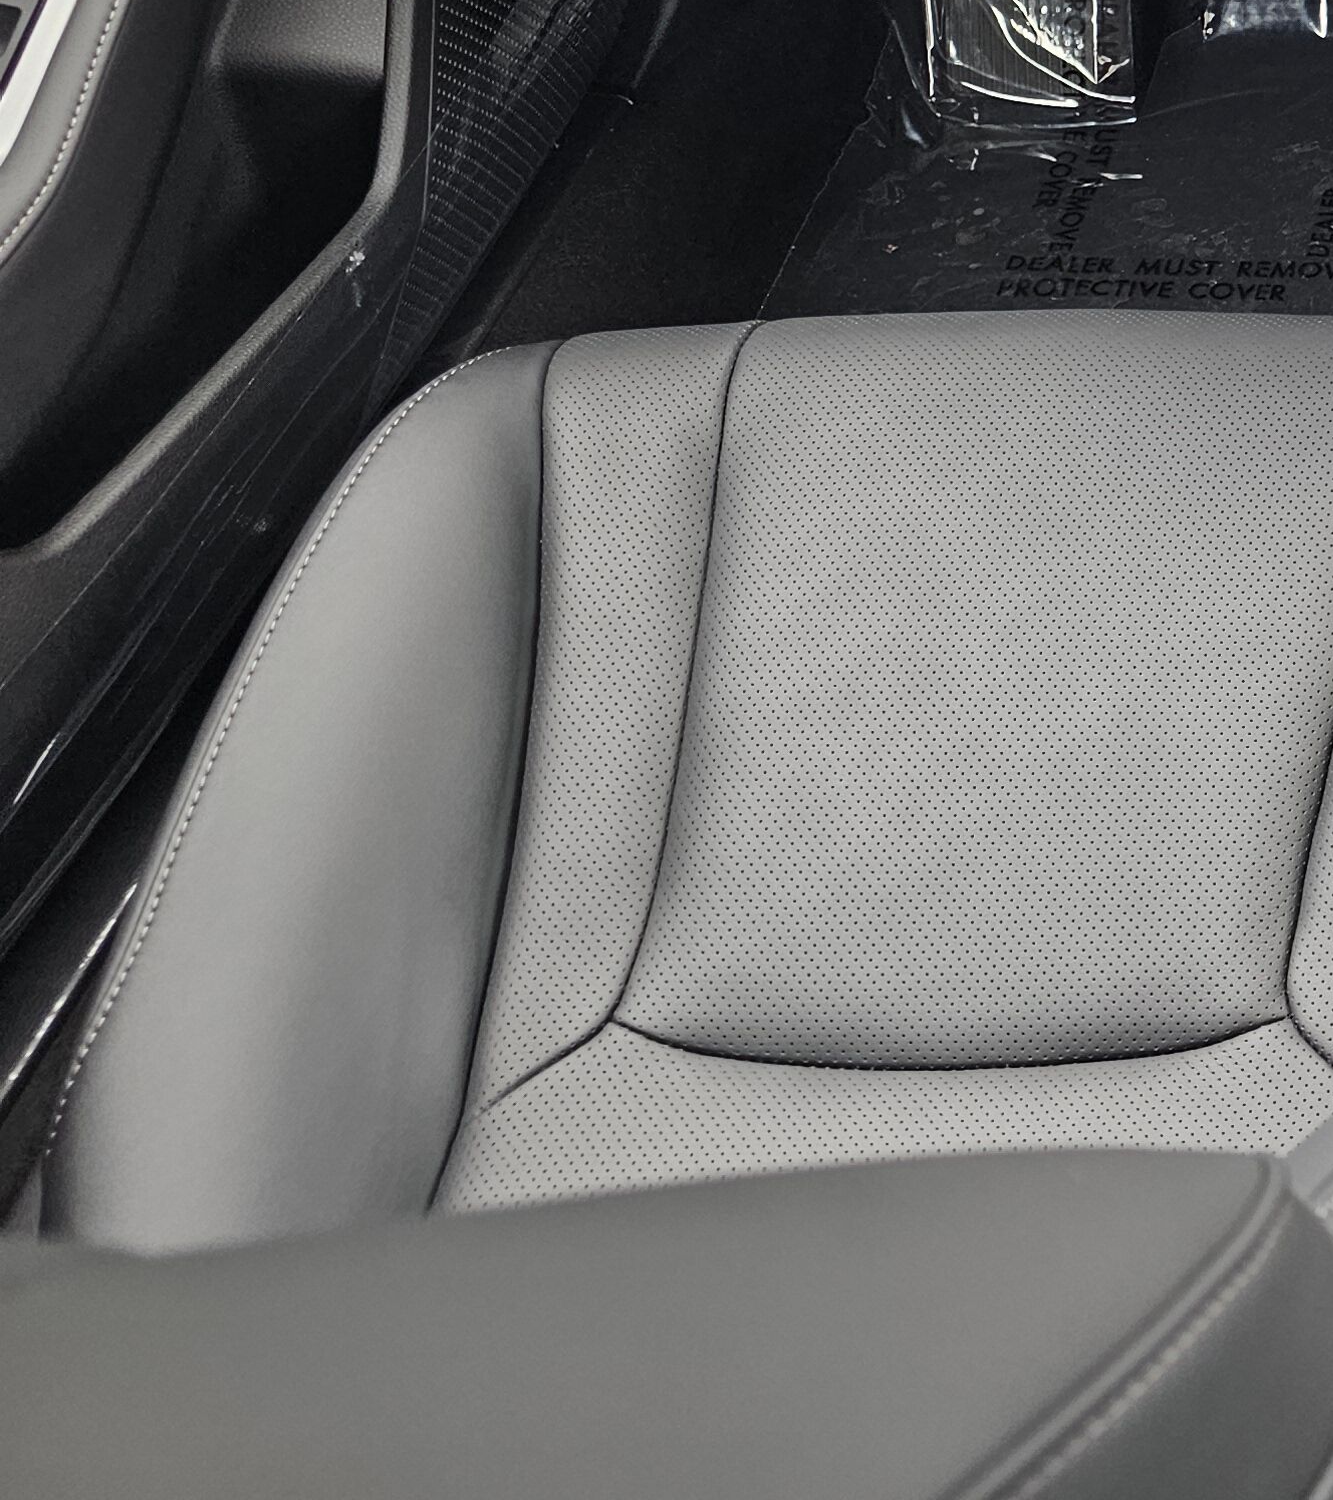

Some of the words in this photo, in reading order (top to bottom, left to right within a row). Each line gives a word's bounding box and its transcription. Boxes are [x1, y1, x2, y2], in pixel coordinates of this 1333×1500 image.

[1004, 256, 1114, 276] DEALER
[1133, 260, 1221, 278] MUST
[996, 277, 1175, 301] PROTECTIVE
[1188, 281, 1287, 302] COVER
